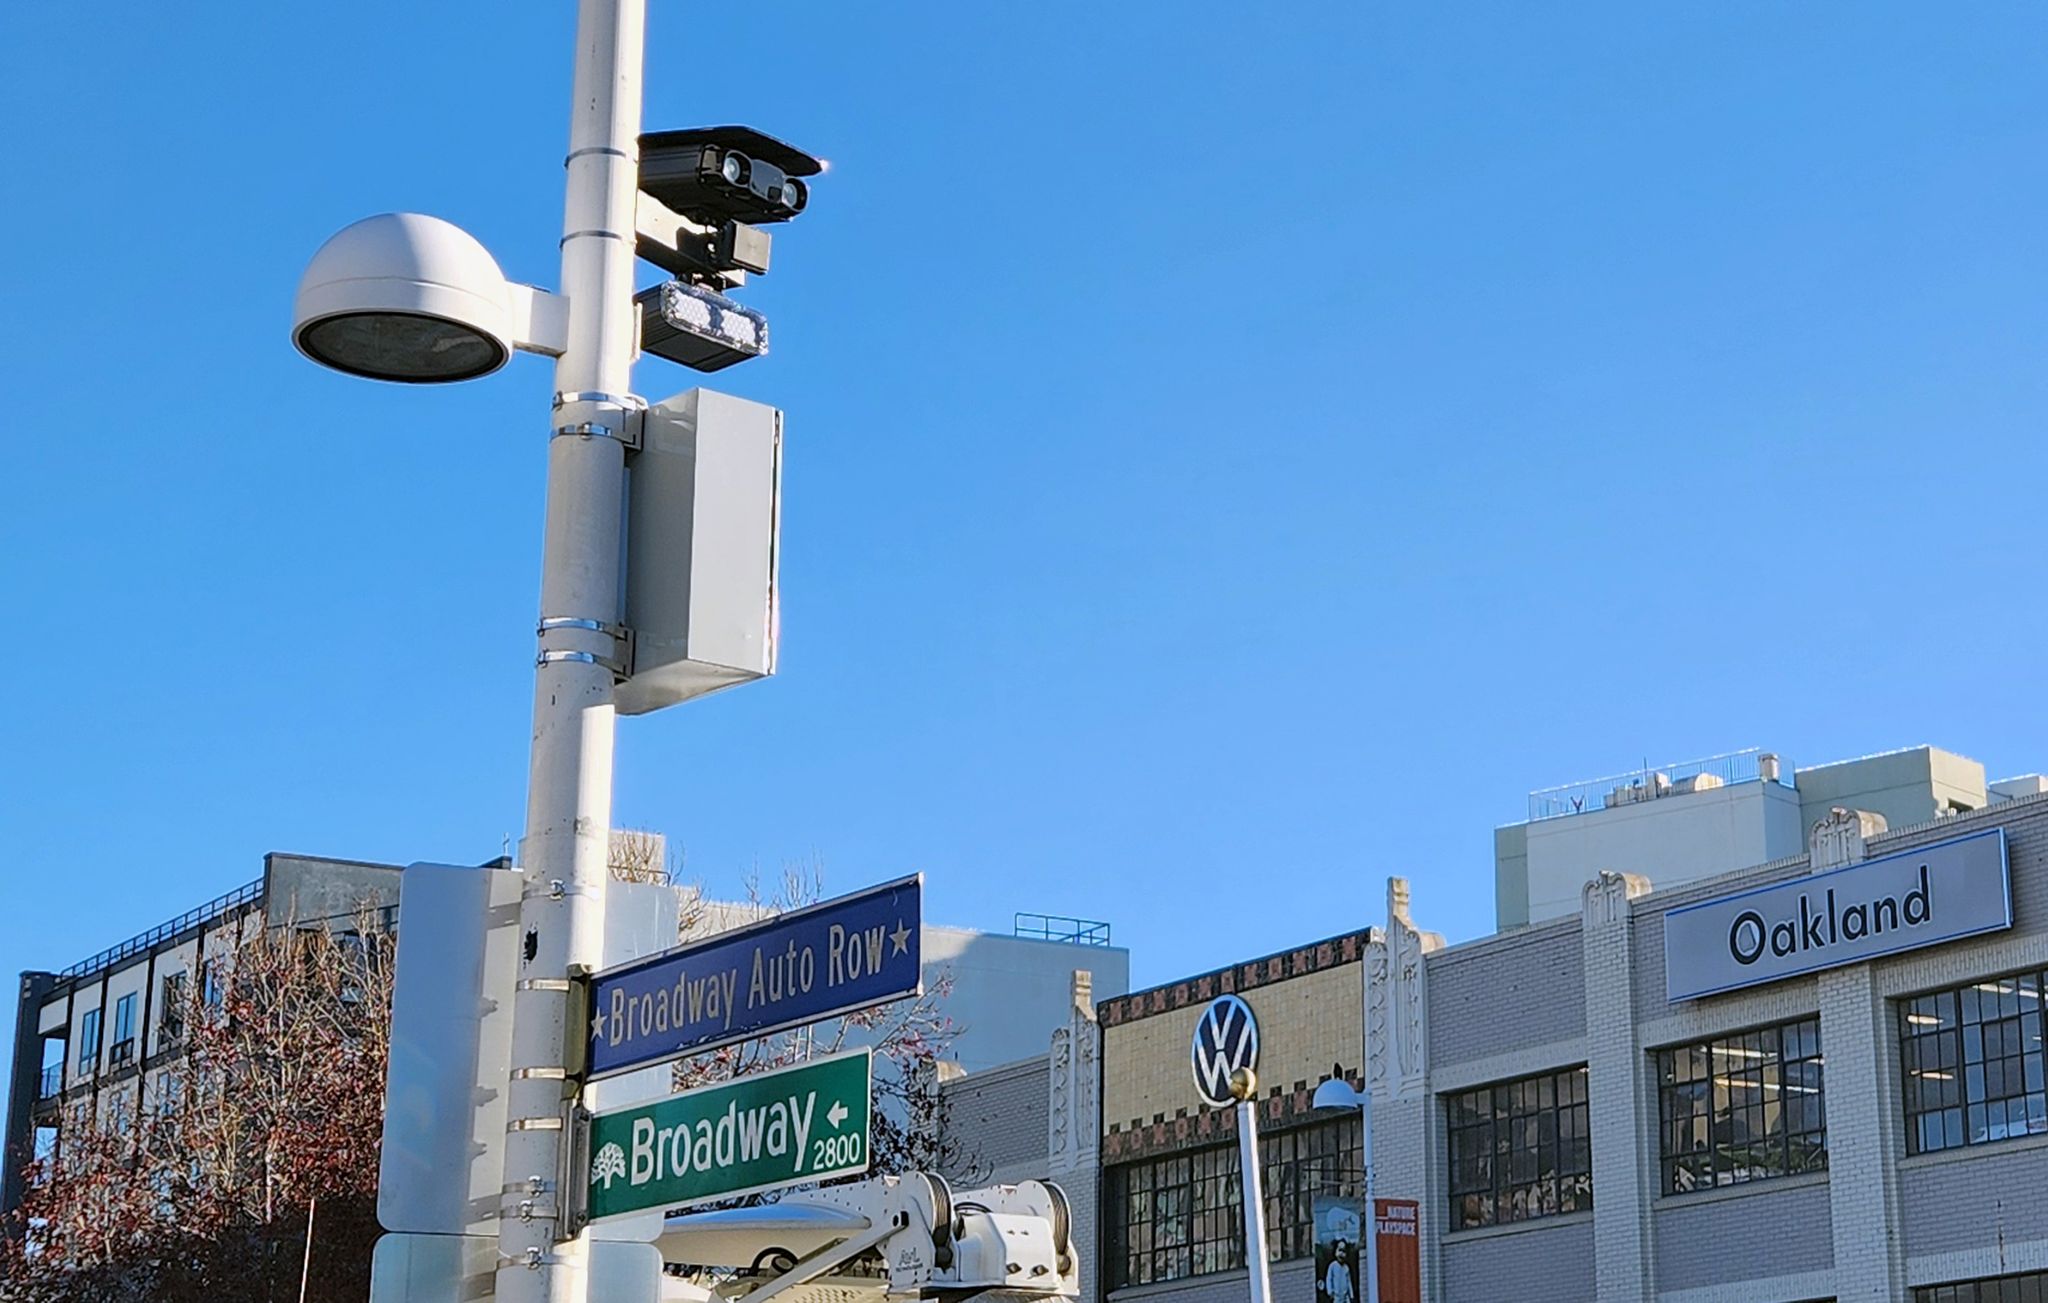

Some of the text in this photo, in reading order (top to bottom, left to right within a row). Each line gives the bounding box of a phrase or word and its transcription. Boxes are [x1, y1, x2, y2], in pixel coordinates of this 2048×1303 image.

[1729, 864, 1931, 965] Oakland
[609, 922, 886, 1047] Broadway Auto Row
[1193, 995, 1258, 1106] VW
[630, 1091, 817, 1186] Broadway
[813, 1132, 860, 1170] 2800
